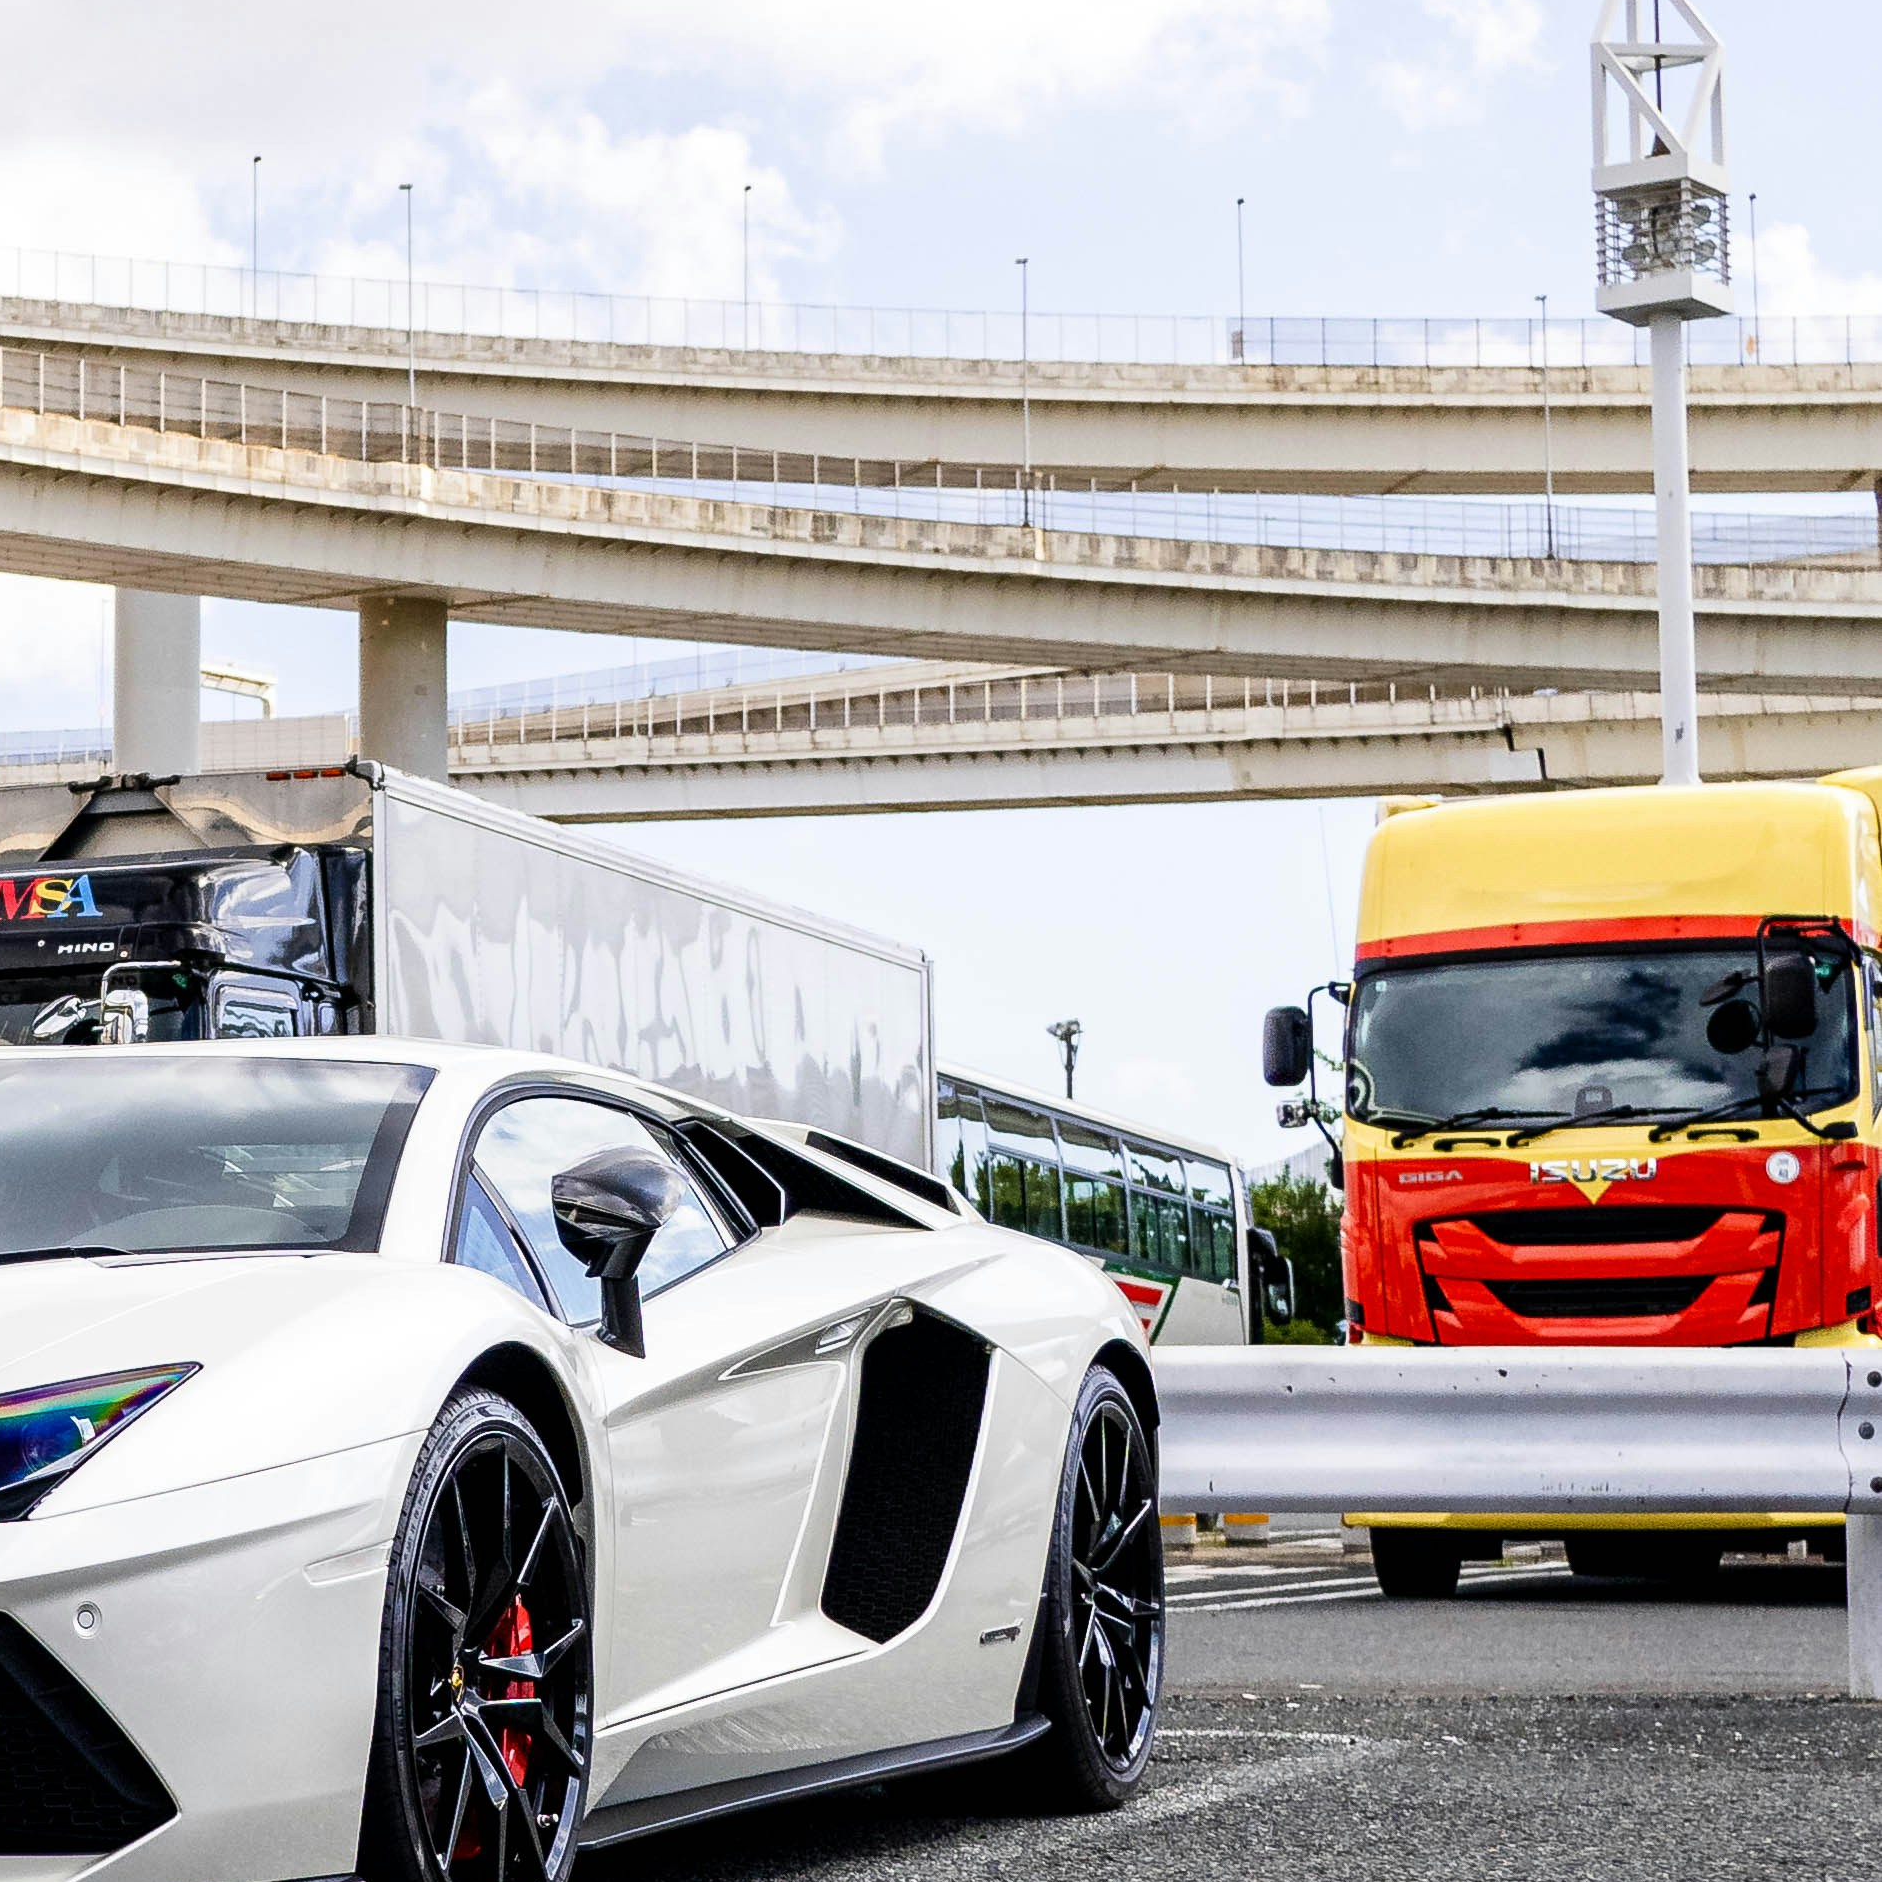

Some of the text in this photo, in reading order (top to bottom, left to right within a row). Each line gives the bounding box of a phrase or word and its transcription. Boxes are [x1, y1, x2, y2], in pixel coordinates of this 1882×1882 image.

[58, 942, 115, 954] HINO
[1399, 1170, 1464, 1184] GIGA
[1530, 1157, 1657, 1184] ISUZU
